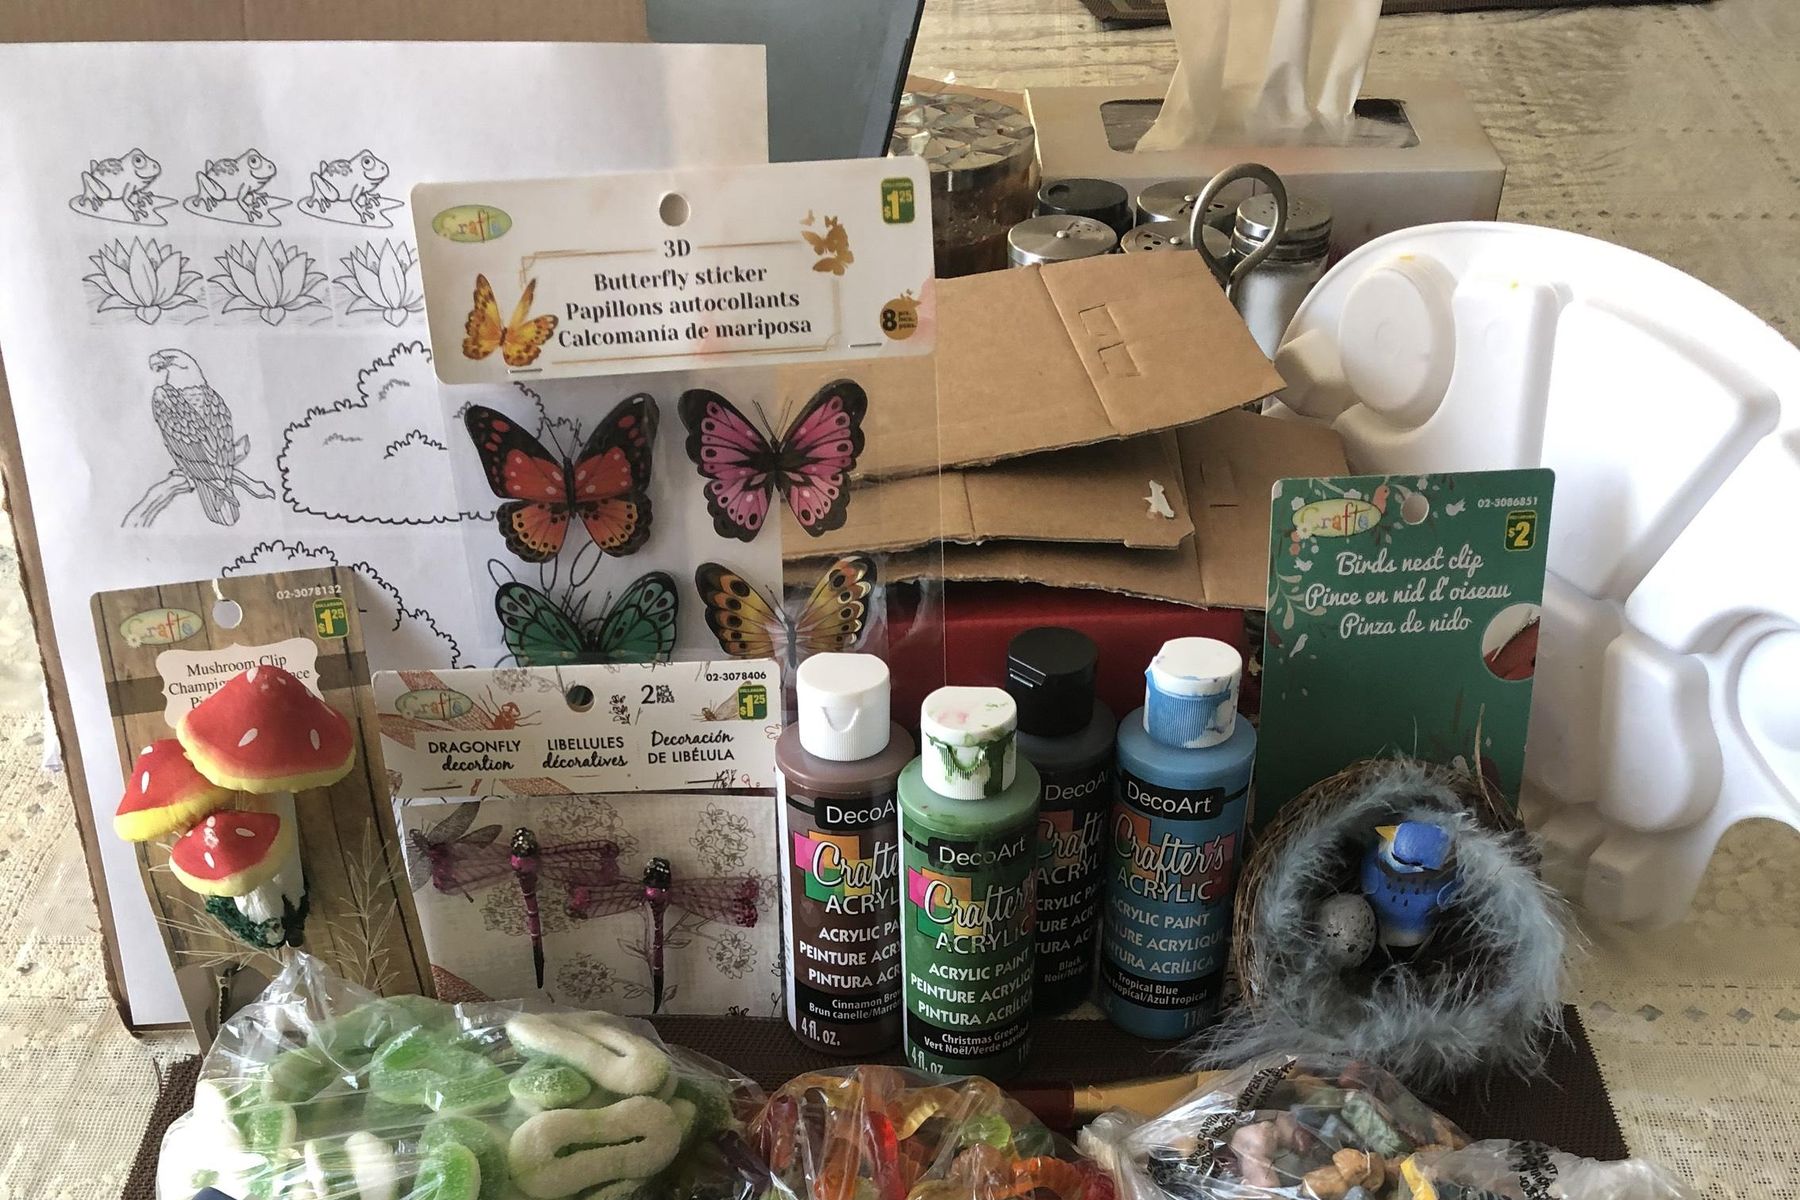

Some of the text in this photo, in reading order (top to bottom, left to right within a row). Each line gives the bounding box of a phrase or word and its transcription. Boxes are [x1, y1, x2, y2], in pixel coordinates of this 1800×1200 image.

[663, 239, 691, 258] 3D
[594, 265, 768, 291] Butterfly sticker
[566, 291, 801, 324] Papillons autocollants
[882, 308, 898, 332] 8
[558, 317, 813, 348] Calcomanía de mariposa
[1477, 497, 1538, 508] 02-3086851
[1508, 520, 1531, 547] $2
[1336, 543, 1485, 578] Birds nest clip
[276, 584, 342, 600] 02-3078132
[1304, 583, 1363, 611] Pince
[1365, 590, 1389, 605] en
[1393, 577, 1426, 603] nid
[1339, 606, 1473, 639] Pinza de nido
[186, 654, 288, 677] Mushroom Clip
[706, 671, 767, 682] 02-3078406
[168, 677, 227, 696] Champi
[641, 684, 656, 705] 2
[428, 740, 521, 754] DRAGONFLY
[547, 736, 624, 751] LIBELLULES
[651, 730, 734, 748] Decoración
[442, 754, 515, 771] decortion
[542, 751, 628, 769] décoratives
[648, 747, 735, 764] DE LIBÉLULA
[1045, 771, 1106, 800] DecoA
[1128, 780, 1212, 814] DecoArt
[826, 798, 896, 824] DecoA
[1039, 812, 1103, 862] Craft
[1115, 813, 1225, 885] Crafter's
[940, 836, 1026, 866] DecoArt
[812, 841, 899, 896] Crafte
[1038, 853, 1098, 886] ACRYL
[1117, 866, 1213, 903] ACRYLIC
[825, 886, 900, 915] ACRYL
[1036, 891, 1083, 912] CRYLIC
[1112, 896, 1160, 928] ACRYLIC
[1164, 913, 1210, 930] PAINT
[819, 926, 880, 943] ACRYLIC
[936, 915, 1029, 954] ACRYLIC
[799, 940, 867, 966] PEINTURE
[929, 949, 1029, 981] ACRYLIC PAINT
[1150, 955, 1214, 975] ACRÍLICA
[808, 968, 873, 989] PINTURA
[911, 972, 975, 1004] PEINTURE
[980, 966, 1033, 1003] ACRYLIQ
[1118, 972, 1153, 993] Tropical
[1155, 985, 1179, 996] Blue
[809, 1000, 900, 1020] Brun canelle/Marro
[832, 989, 900, 1009] Cinnamon Bro
[919, 1000, 981, 1026] PINTURA
[801, 1017, 840, 1046] 4 fl. oz.
[924, 1036, 943, 1052] Vert
[942, 1033, 992, 1045] Christmas
[994, 1024, 1019, 1041] Green
[911, 1046, 917, 1063] 4
